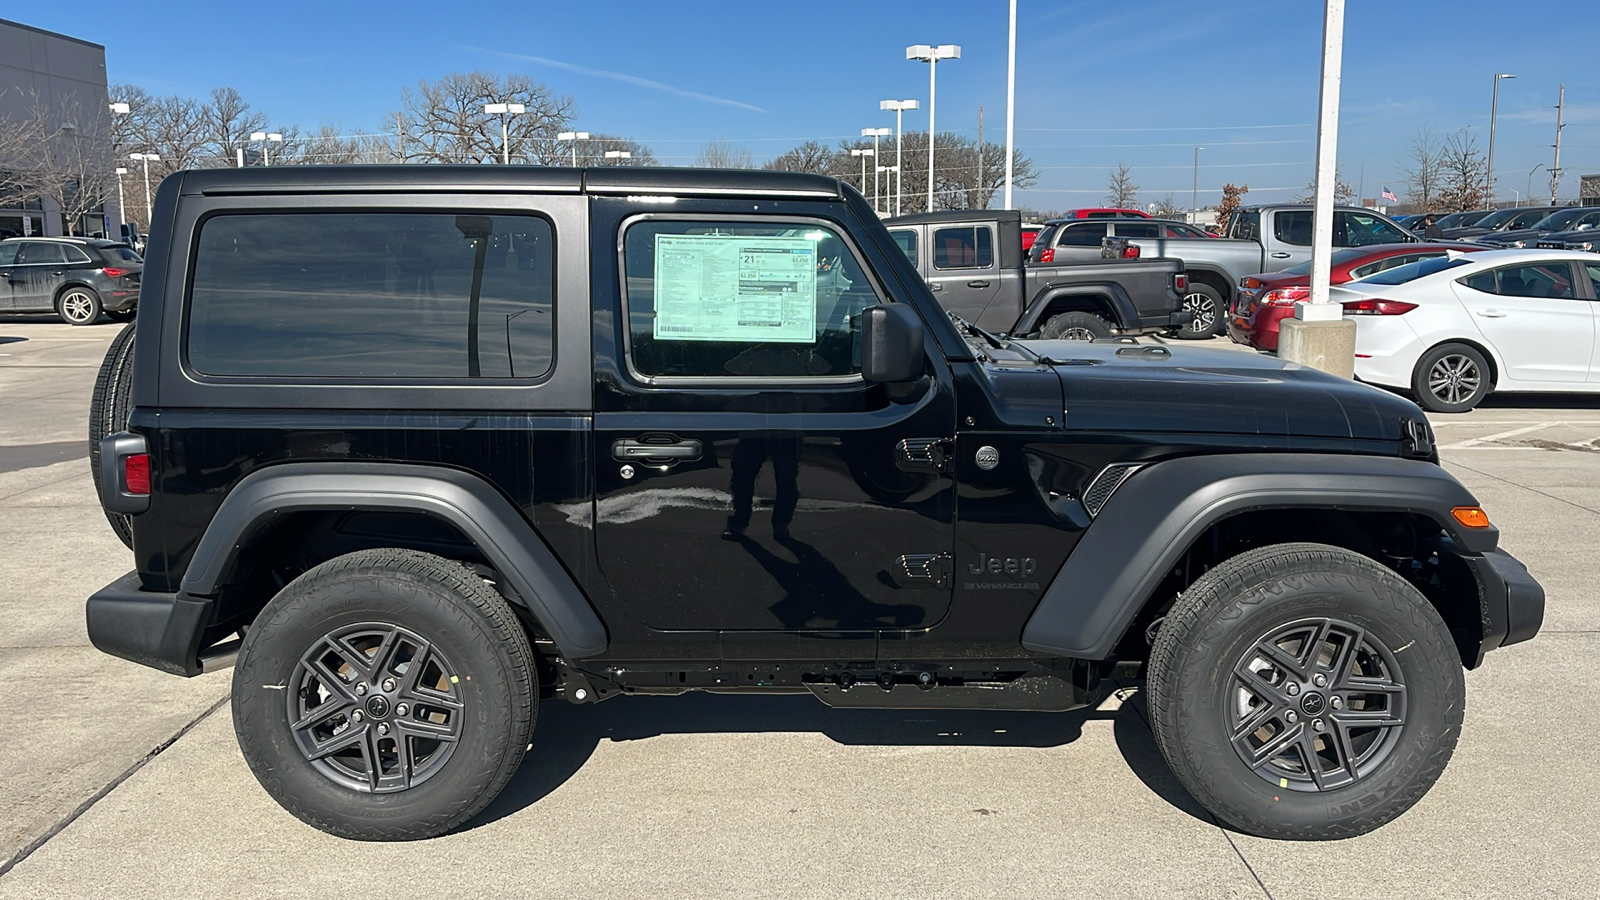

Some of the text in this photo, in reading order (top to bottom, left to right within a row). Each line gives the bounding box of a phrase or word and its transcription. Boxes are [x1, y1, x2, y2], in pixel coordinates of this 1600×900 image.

[744, 255, 754, 263] 21
[968, 552, 1037, 578] Jeep
[975, 582, 1040, 590] WRANGLER
